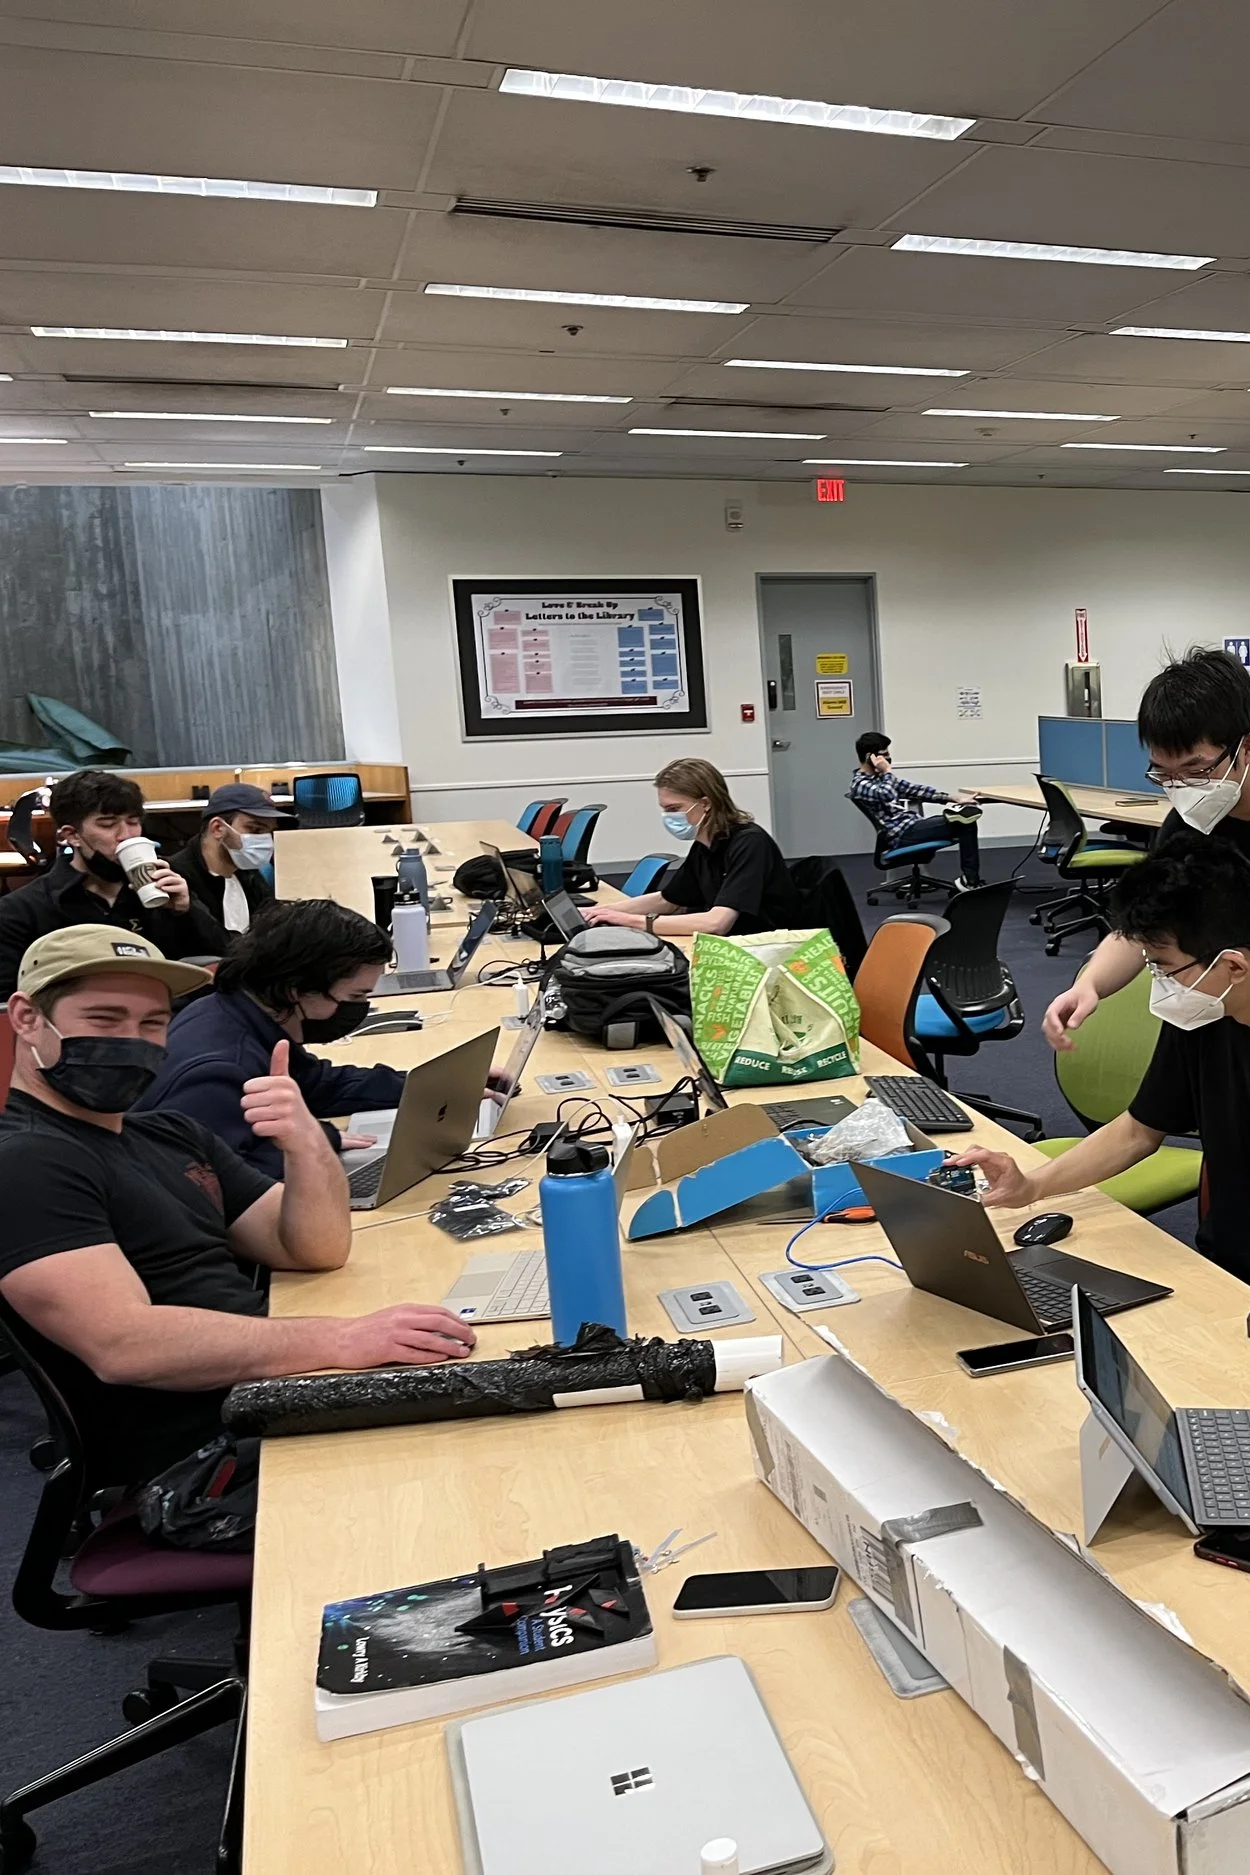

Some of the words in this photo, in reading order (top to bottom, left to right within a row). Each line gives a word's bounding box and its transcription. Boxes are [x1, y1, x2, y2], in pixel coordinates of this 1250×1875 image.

[817, 479, 845, 502] EXIT
[541, 601, 565, 609] Love
[565, 612, 576, 620] to
[577, 612, 595, 620] the
[596, 611, 635, 621] Library
[734, 1056, 771, 1071] REDUCE
[816, 1050, 848, 1068] RECYCLE
